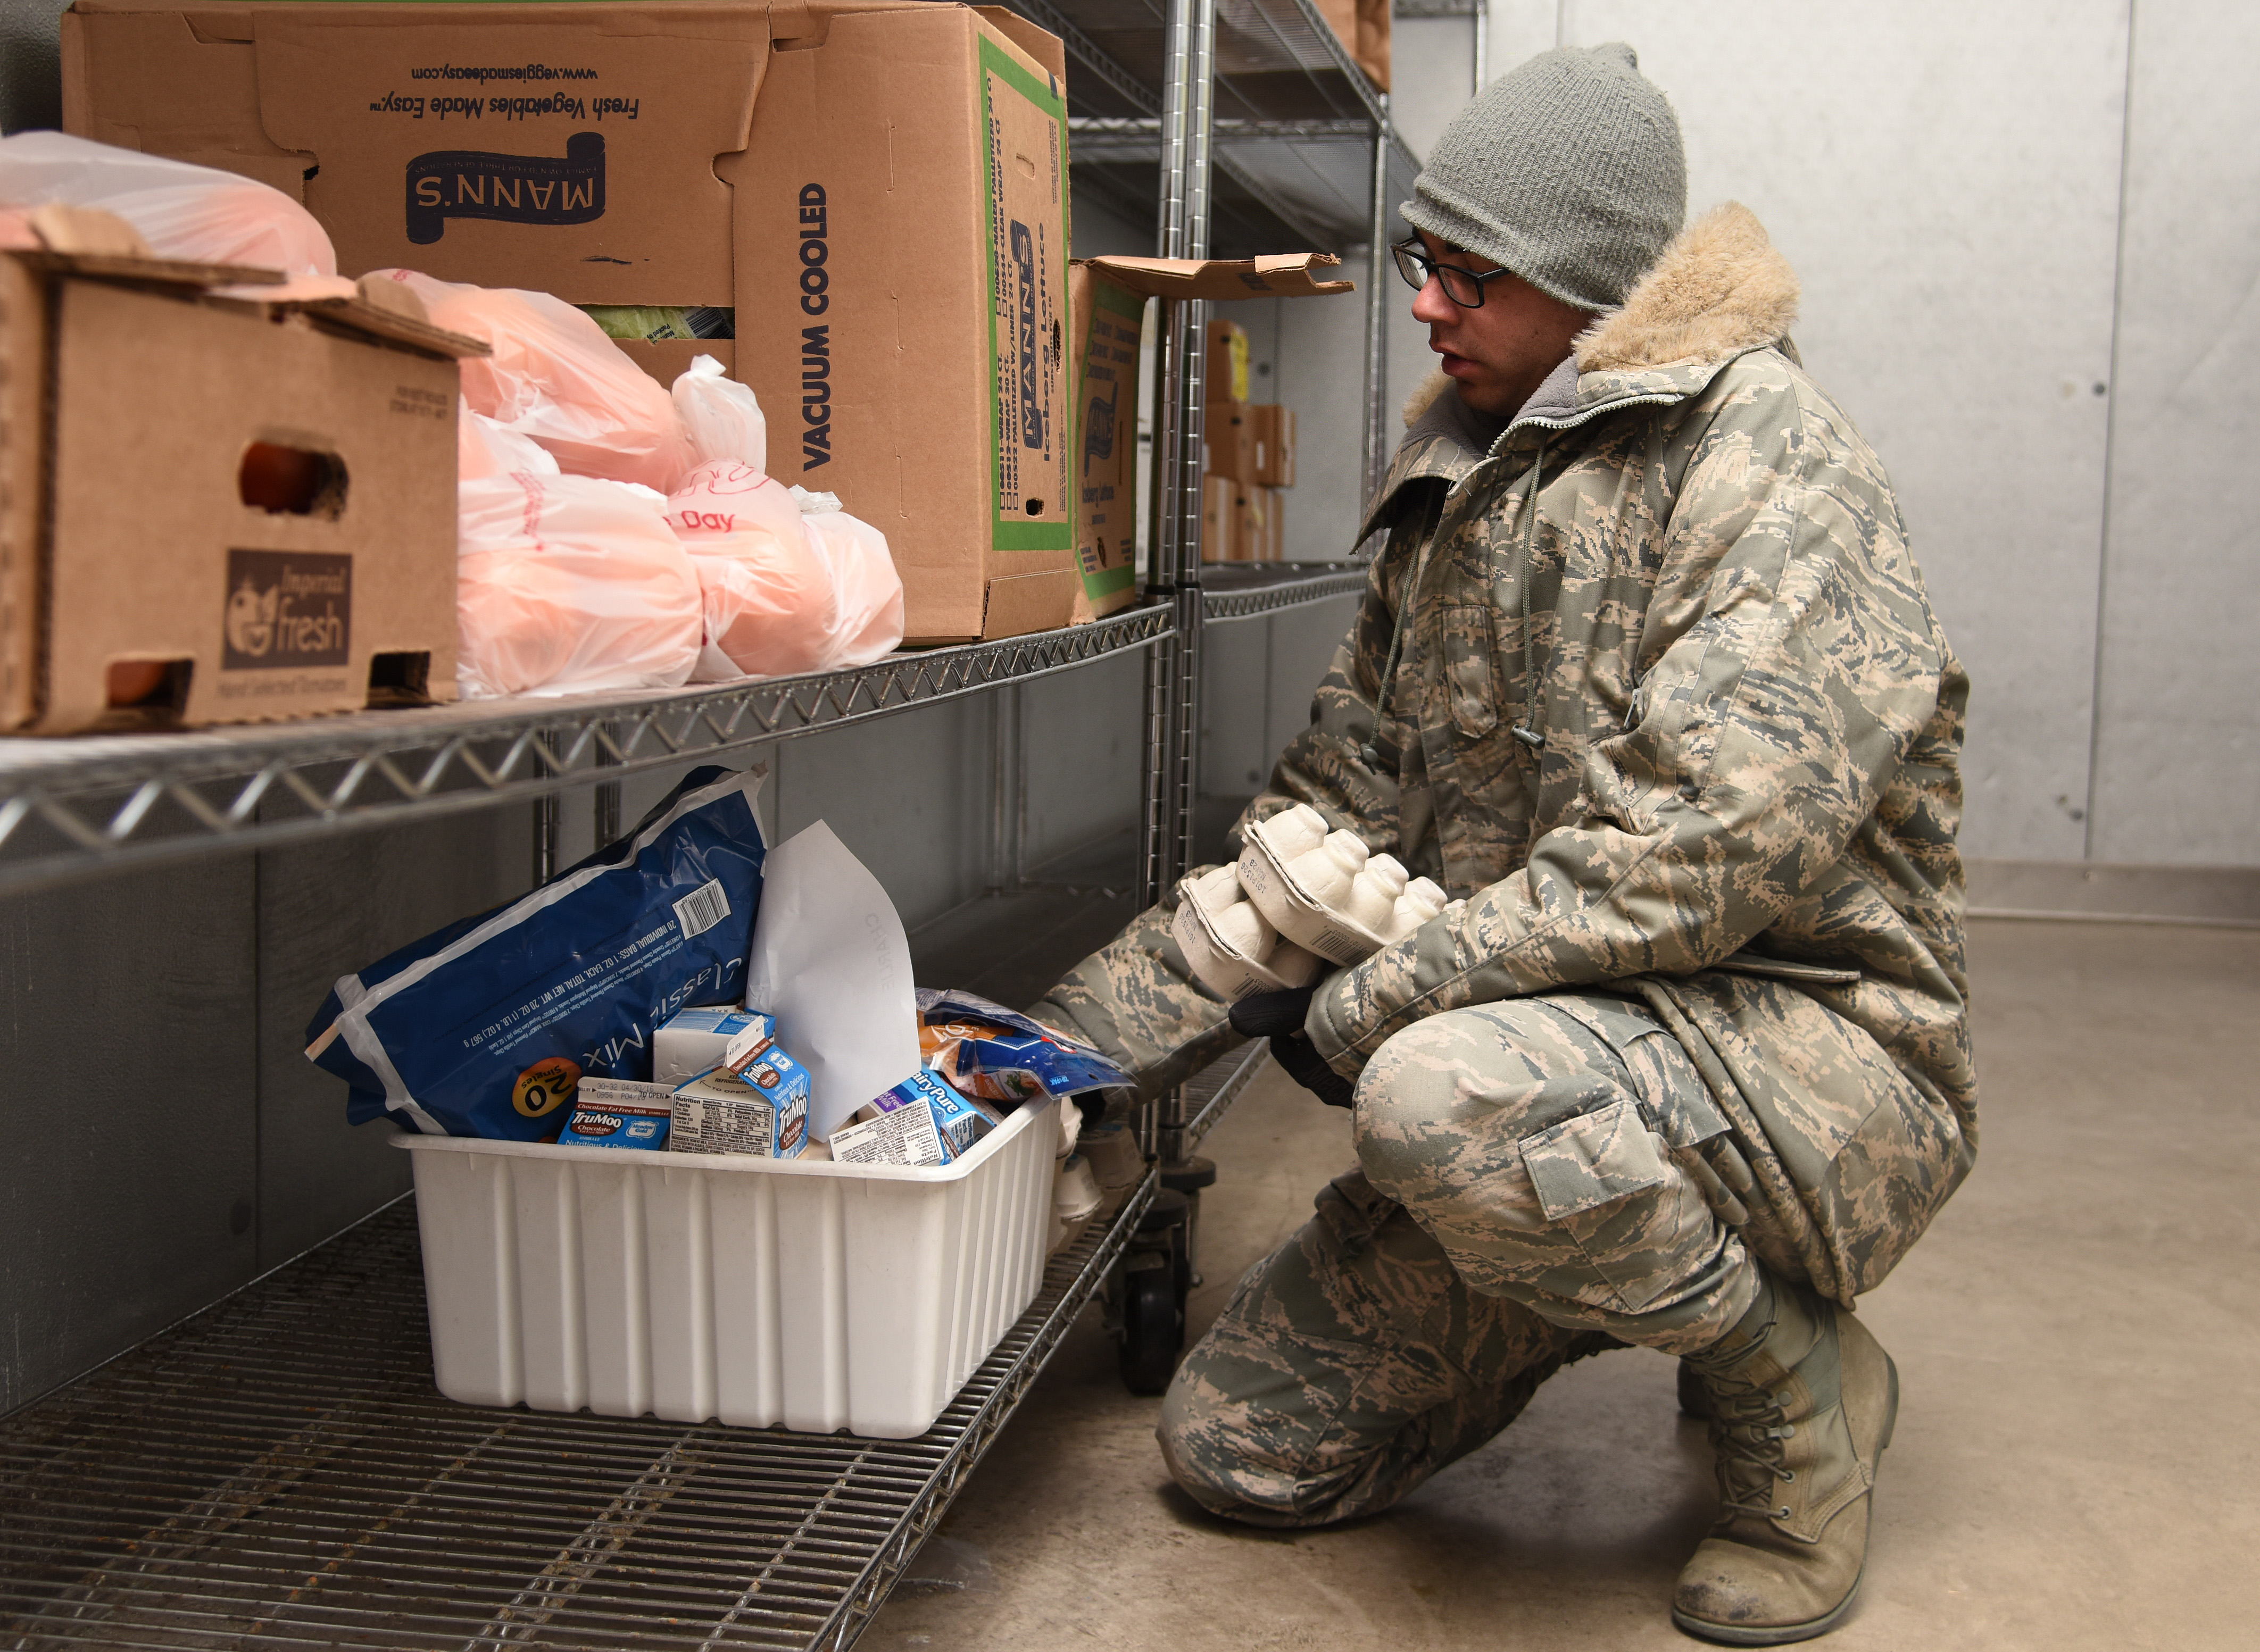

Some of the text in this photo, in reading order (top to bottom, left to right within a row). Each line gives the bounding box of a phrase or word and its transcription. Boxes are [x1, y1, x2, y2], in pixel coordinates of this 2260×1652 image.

[411, 63, 597, 85] www.veggiesmadeeasy.com
[431, 97, 484, 119] Made
[489, 91, 585, 120] Vegetables
[593, 97, 638, 120] Fresh
[988, 96, 993, 114] 24
[997, 138, 1001, 156] 24
[416, 174, 593, 210] MANN'S
[1009, 283, 1013, 299] 24
[652, 323, 671, 336] Packed
[799, 183, 830, 471] VACUUM COOLED
[1019, 233, 1033, 436] MANN'S
[999, 376, 1002, 394] 24
[1005, 378, 1009, 395] 30
[1041, 345, 1050, 461] Iceberg
[682, 511, 735, 532] Day
[277, 599, 343, 653] fresh
[666, 920, 676, 931] 20
[635, 924, 669, 949] INDIVIDUAL
[617, 944, 638, 960] BAGS:
[583, 962, 603, 979] EACH,
[601, 957, 614, 969] OZ.
[563, 972, 585, 991] TOTAL
[537, 991, 553, 1005] WT.
[551, 984, 566, 997] NET
[517, 1004, 531, 1016] OZ.
[528, 998, 539, 1010] 20
[500, 1015, 512, 1028] LB.
[510, 1009, 519, 1021] (1
[583, 957, 743, 1071] Classic Mix
[480, 1024, 497, 1039] OZ.)
[494, 1021, 502, 1031] 4
[462, 1039, 470, 1048] g
[468, 1032, 484, 1046] 567
[733, 1061, 746, 1071] Chocolate
[744, 1062, 773, 1083] TruMoo
[521, 1065, 563, 1089] Singles
[761, 1072, 776, 1085] Chocolate
[526, 1077, 575, 1112] 20
[774, 1086, 790, 1101] Nutritious
[791, 1073, 804, 1087] Delicious
[912, 1071, 959, 1113] airyPure
[877, 1095, 892, 1108] Milk
[890, 1096, 902, 1109] Free
[572, 1111, 621, 1128] TruMoo
[779, 1097, 807, 1138] TruMoo
[783, 1120, 802, 1142] Chocolate
[566, 1139, 602, 1148] Nutritious
[912, 1153, 938, 1166] Nutrition
[920, 1148, 936, 1157] Facts
